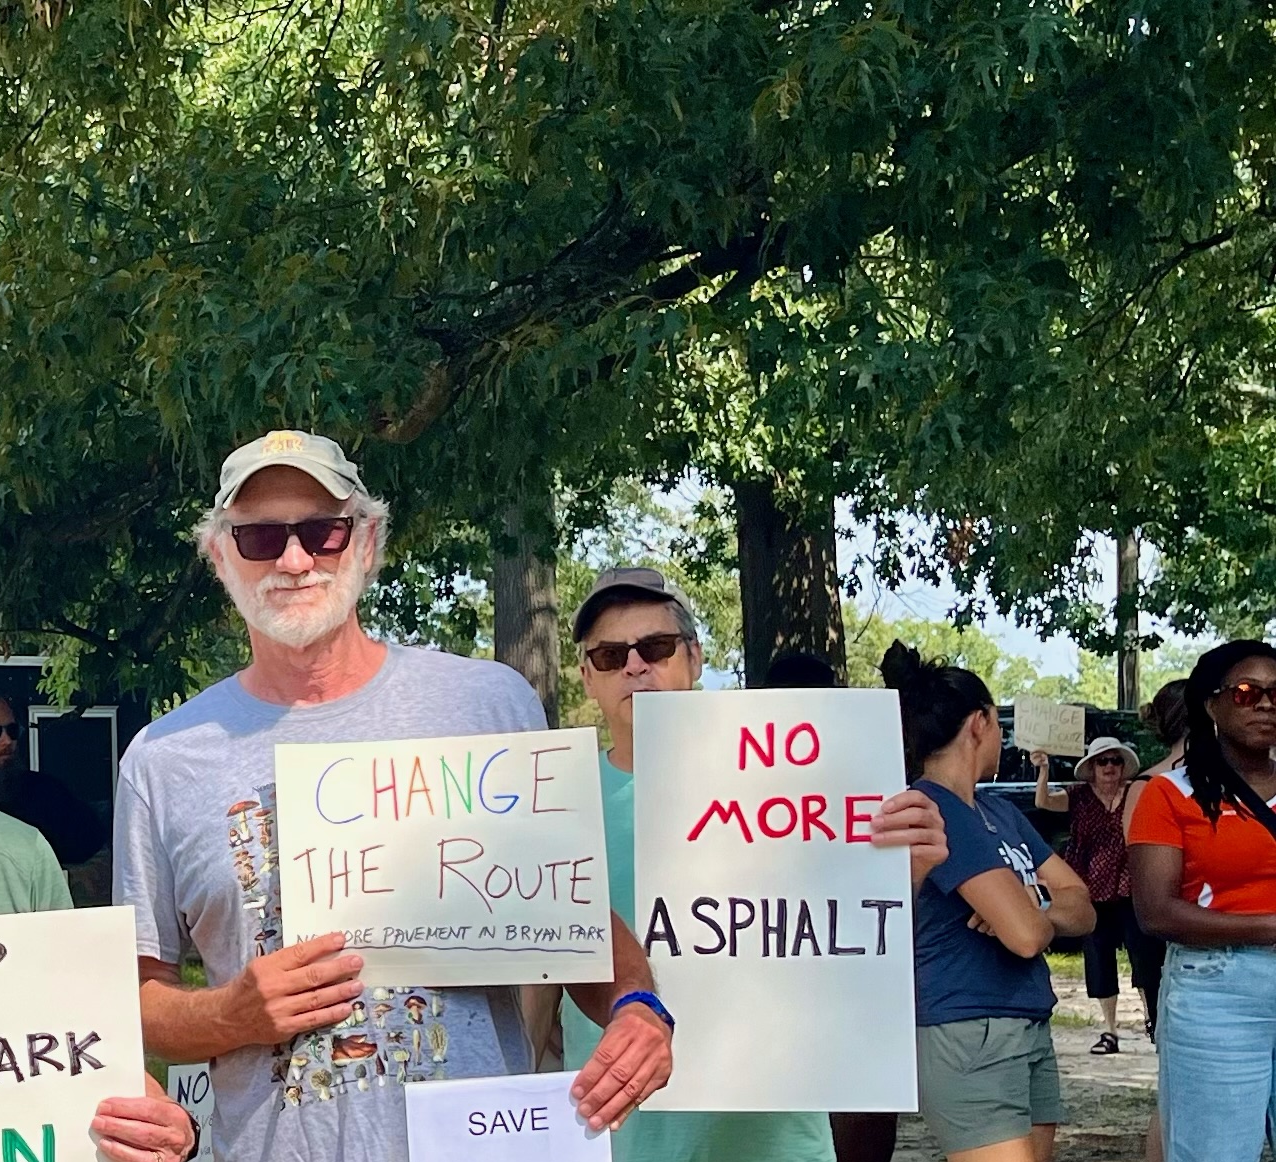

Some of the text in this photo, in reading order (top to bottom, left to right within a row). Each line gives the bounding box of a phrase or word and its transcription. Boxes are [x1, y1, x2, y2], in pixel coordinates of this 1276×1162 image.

[1019, 698, 1081, 726] CHANGE
[739, 722, 820, 770] NO
[316, 747, 572, 825] CHANGE
[687, 795, 884, 844] MORE
[294, 838, 594, 913] THE ROUTE
[331, 926, 374, 945] ORE
[383, 925, 472, 945] PAVEMENT
[478, 925, 496, 940] IN
[505, 924, 562, 944] BRYAN
[568, 924, 606, 943] PARK
[645, 897, 903, 958] ASPHALT
[177, 1070, 210, 1105] NO
[469, 1107, 550, 1136] SAVE
